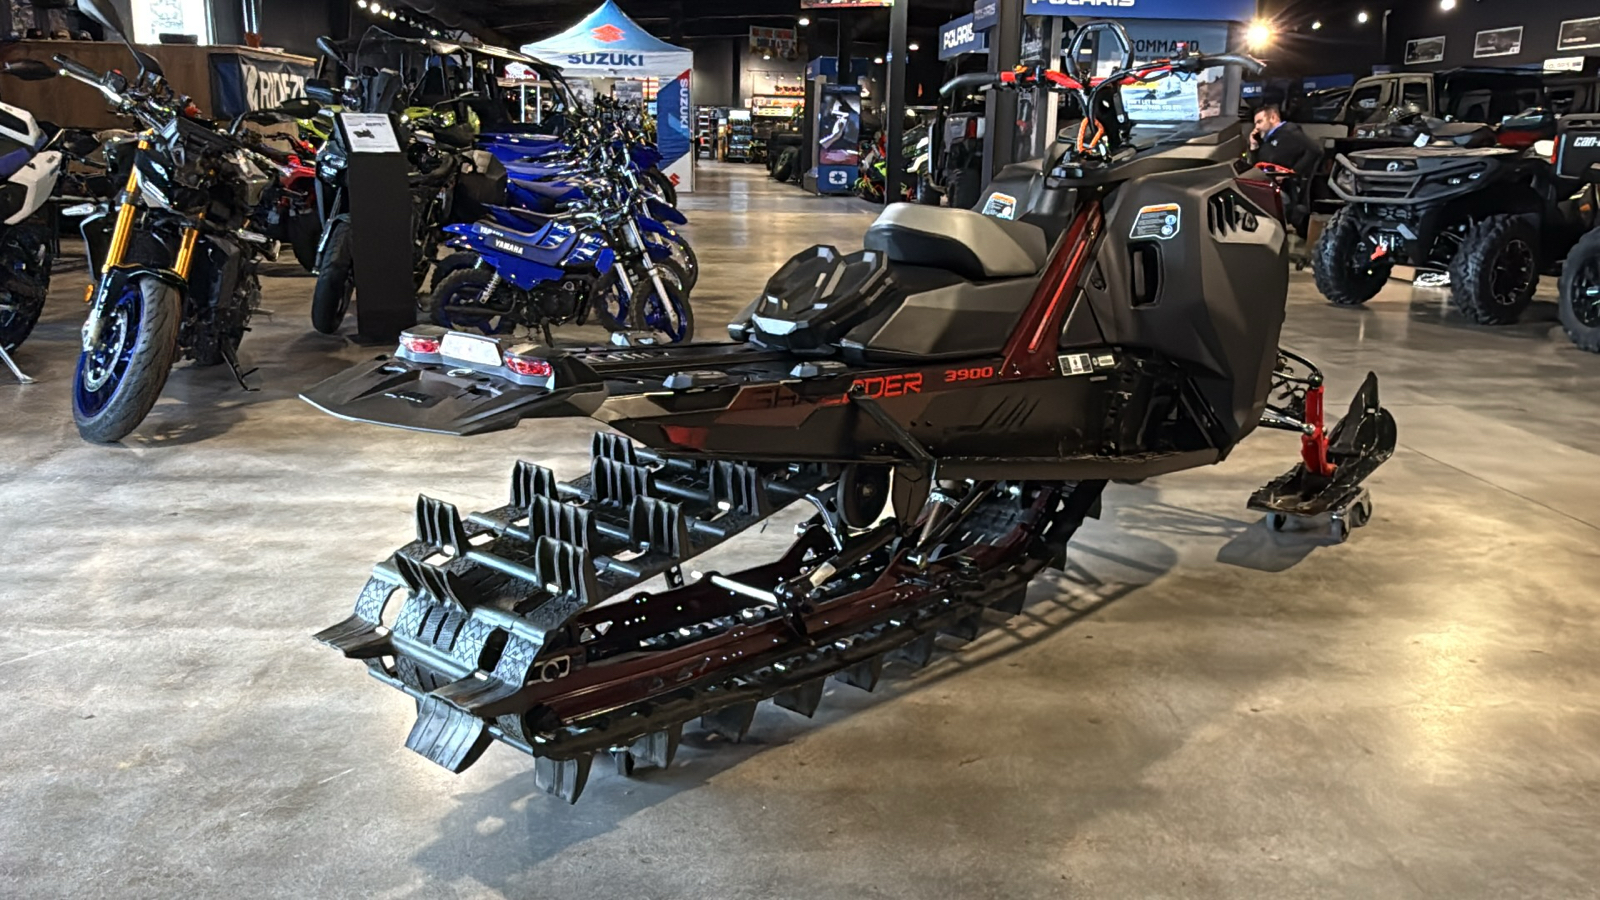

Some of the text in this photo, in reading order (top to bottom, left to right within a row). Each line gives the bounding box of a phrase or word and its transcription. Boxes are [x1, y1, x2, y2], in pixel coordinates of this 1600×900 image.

[943, 22, 975, 50] POLARIS
[1129, 39, 1199, 53] OMMAD
[567, 53, 644, 66] SUZUKI
[679, 78, 688, 129] SUZUKI
[495, 239, 524, 254] YAMAHA
[944, 366, 993, 382] 3900
